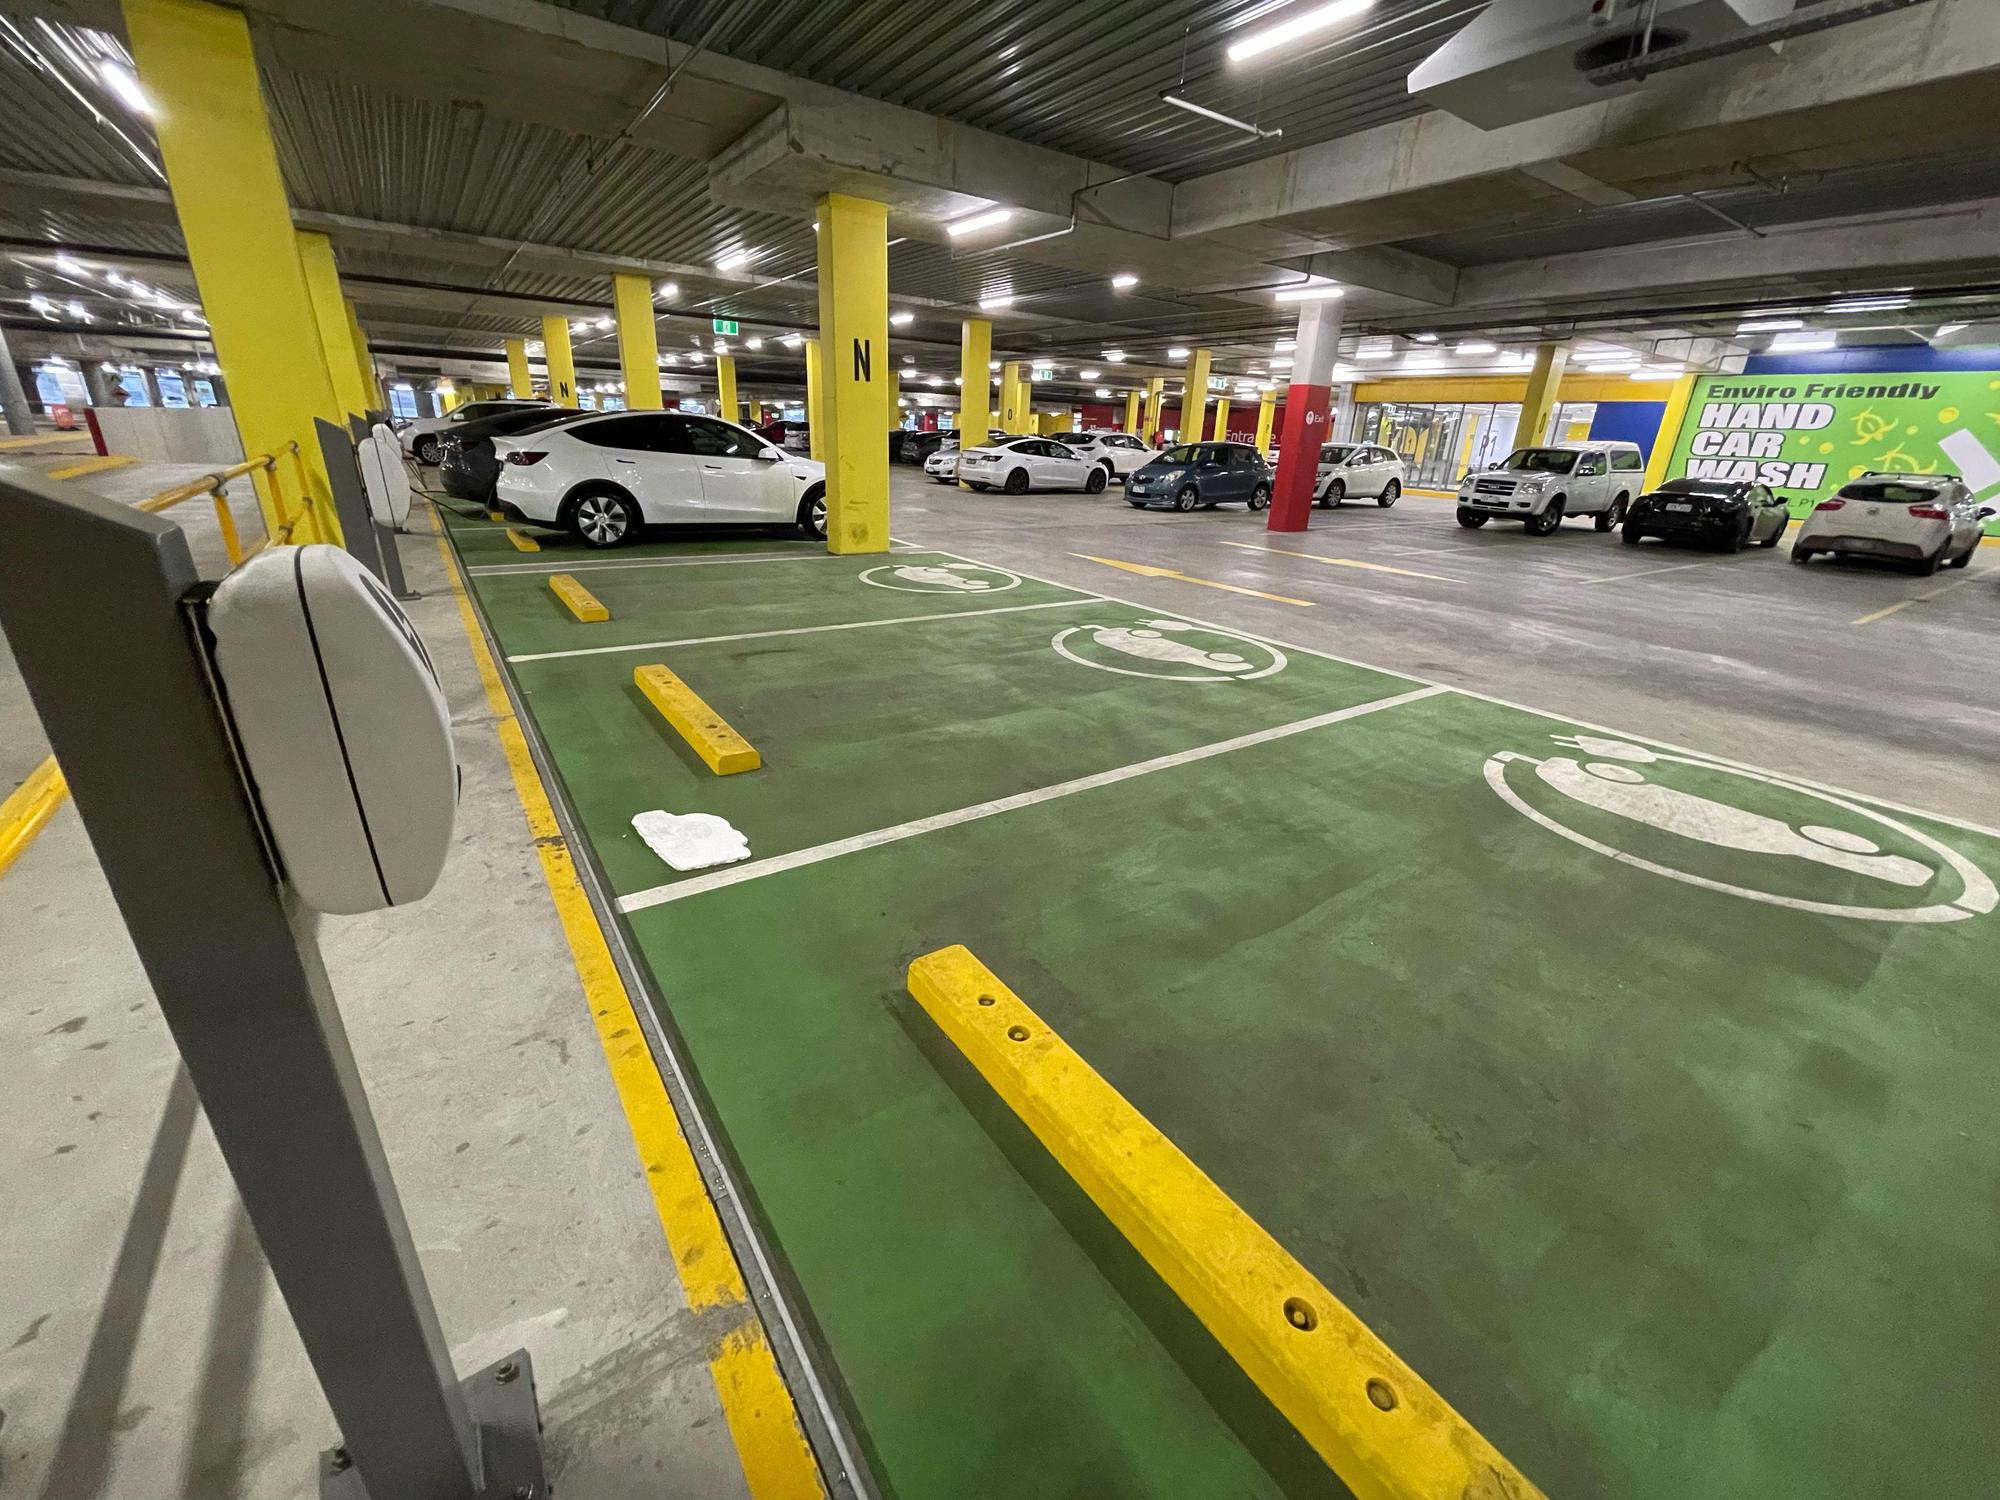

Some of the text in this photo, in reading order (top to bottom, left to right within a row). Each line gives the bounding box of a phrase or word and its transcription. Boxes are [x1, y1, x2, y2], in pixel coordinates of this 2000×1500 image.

[853, 338, 871, 382] N
[559, 381, 569, 398] N
[1706, 383, 1942, 400] Enviro Friendly
[1697, 402, 1837, 430] HAND
[1225, 429, 1276, 443] Entrae
[1479, 434, 1497, 457] P1
[1690, 430, 1786, 458] CAR
[1686, 458, 1828, 490] WASH
